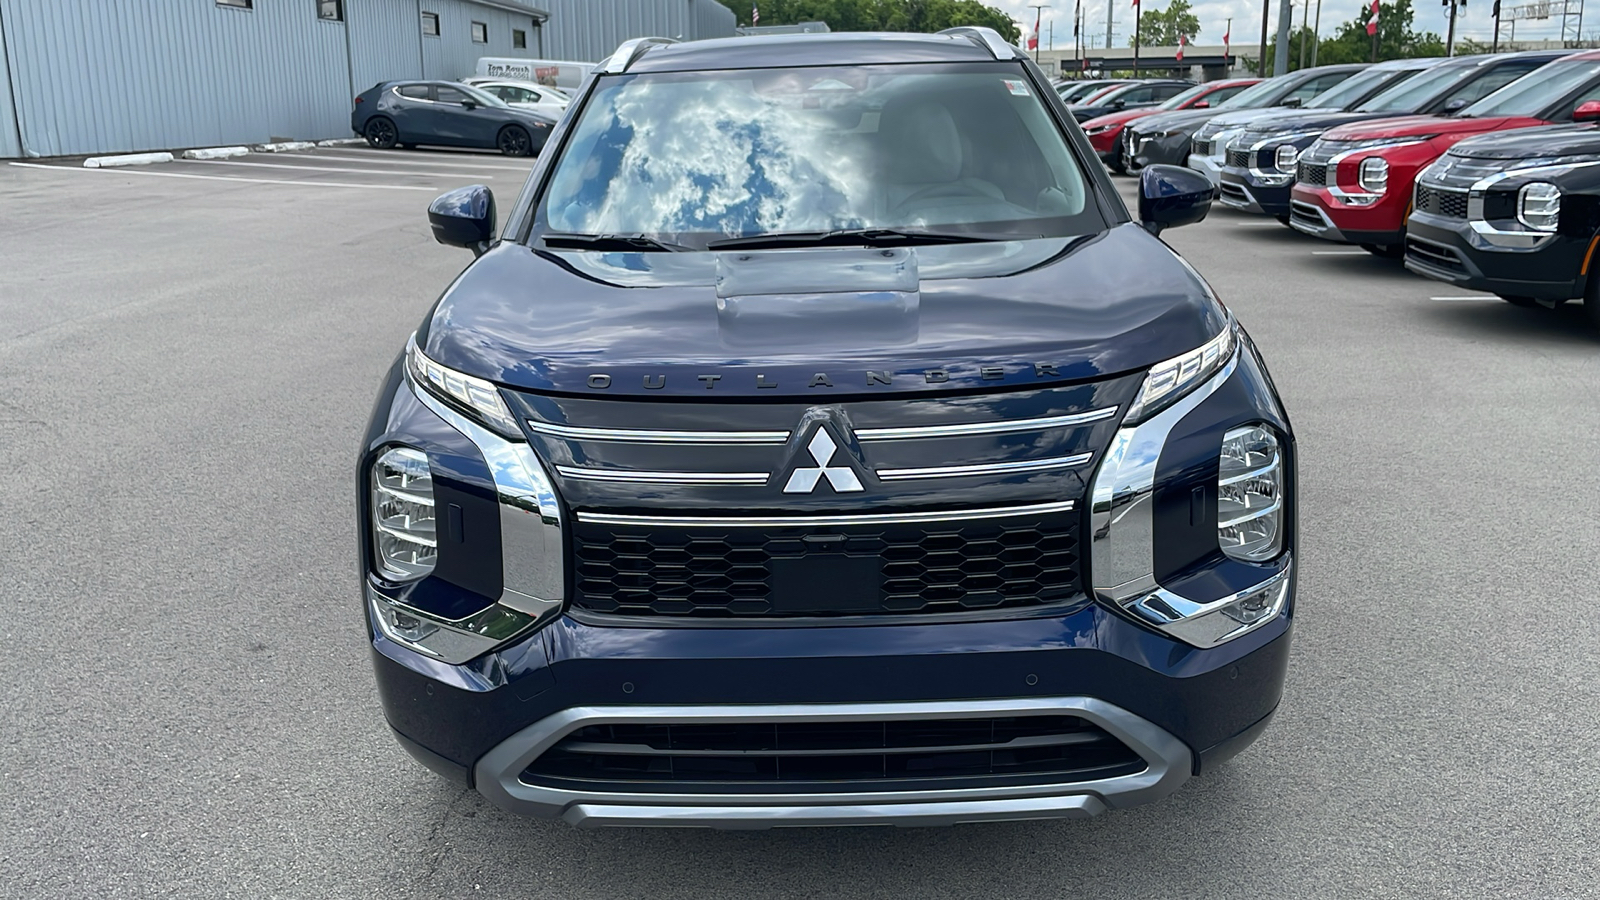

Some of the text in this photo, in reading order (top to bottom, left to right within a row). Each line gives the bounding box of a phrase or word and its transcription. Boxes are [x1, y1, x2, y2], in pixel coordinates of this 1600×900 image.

[488, 64, 503, 72] Tom
[505, 65, 530, 73] Roush
[586, 362, 1061, 389] OUTLANDER
